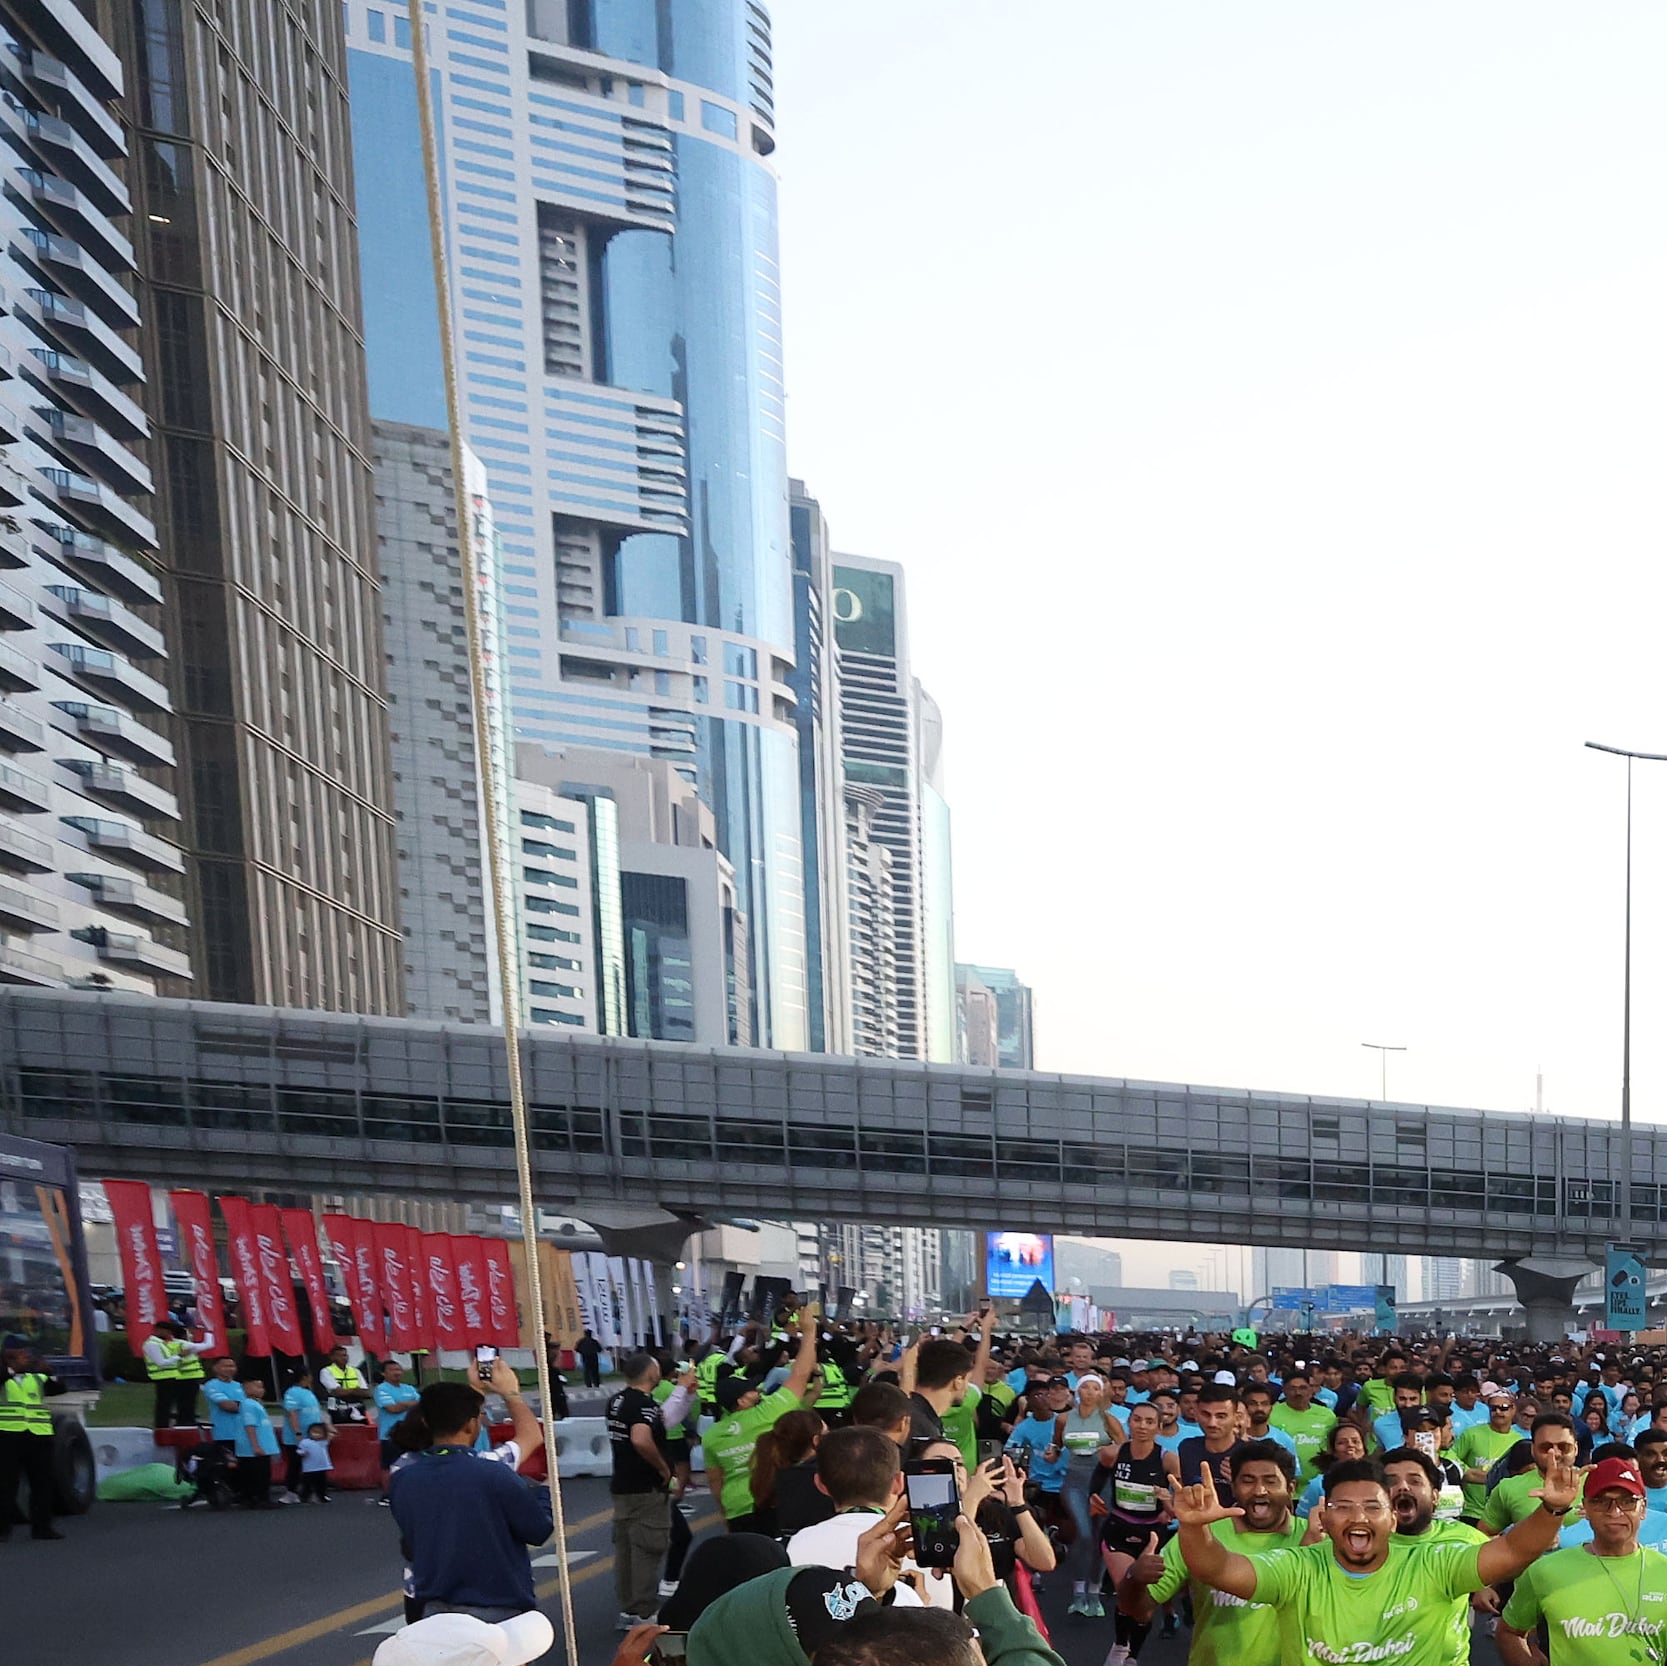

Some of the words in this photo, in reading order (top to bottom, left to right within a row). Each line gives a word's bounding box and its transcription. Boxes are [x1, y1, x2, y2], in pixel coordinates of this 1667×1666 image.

[1561, 1617, 1605, 1639] Mai
[1605, 1613, 1664, 1638] Dubai
[1306, 1637, 1349, 1665] Mai
[1352, 1633, 1416, 1663] Dubai
